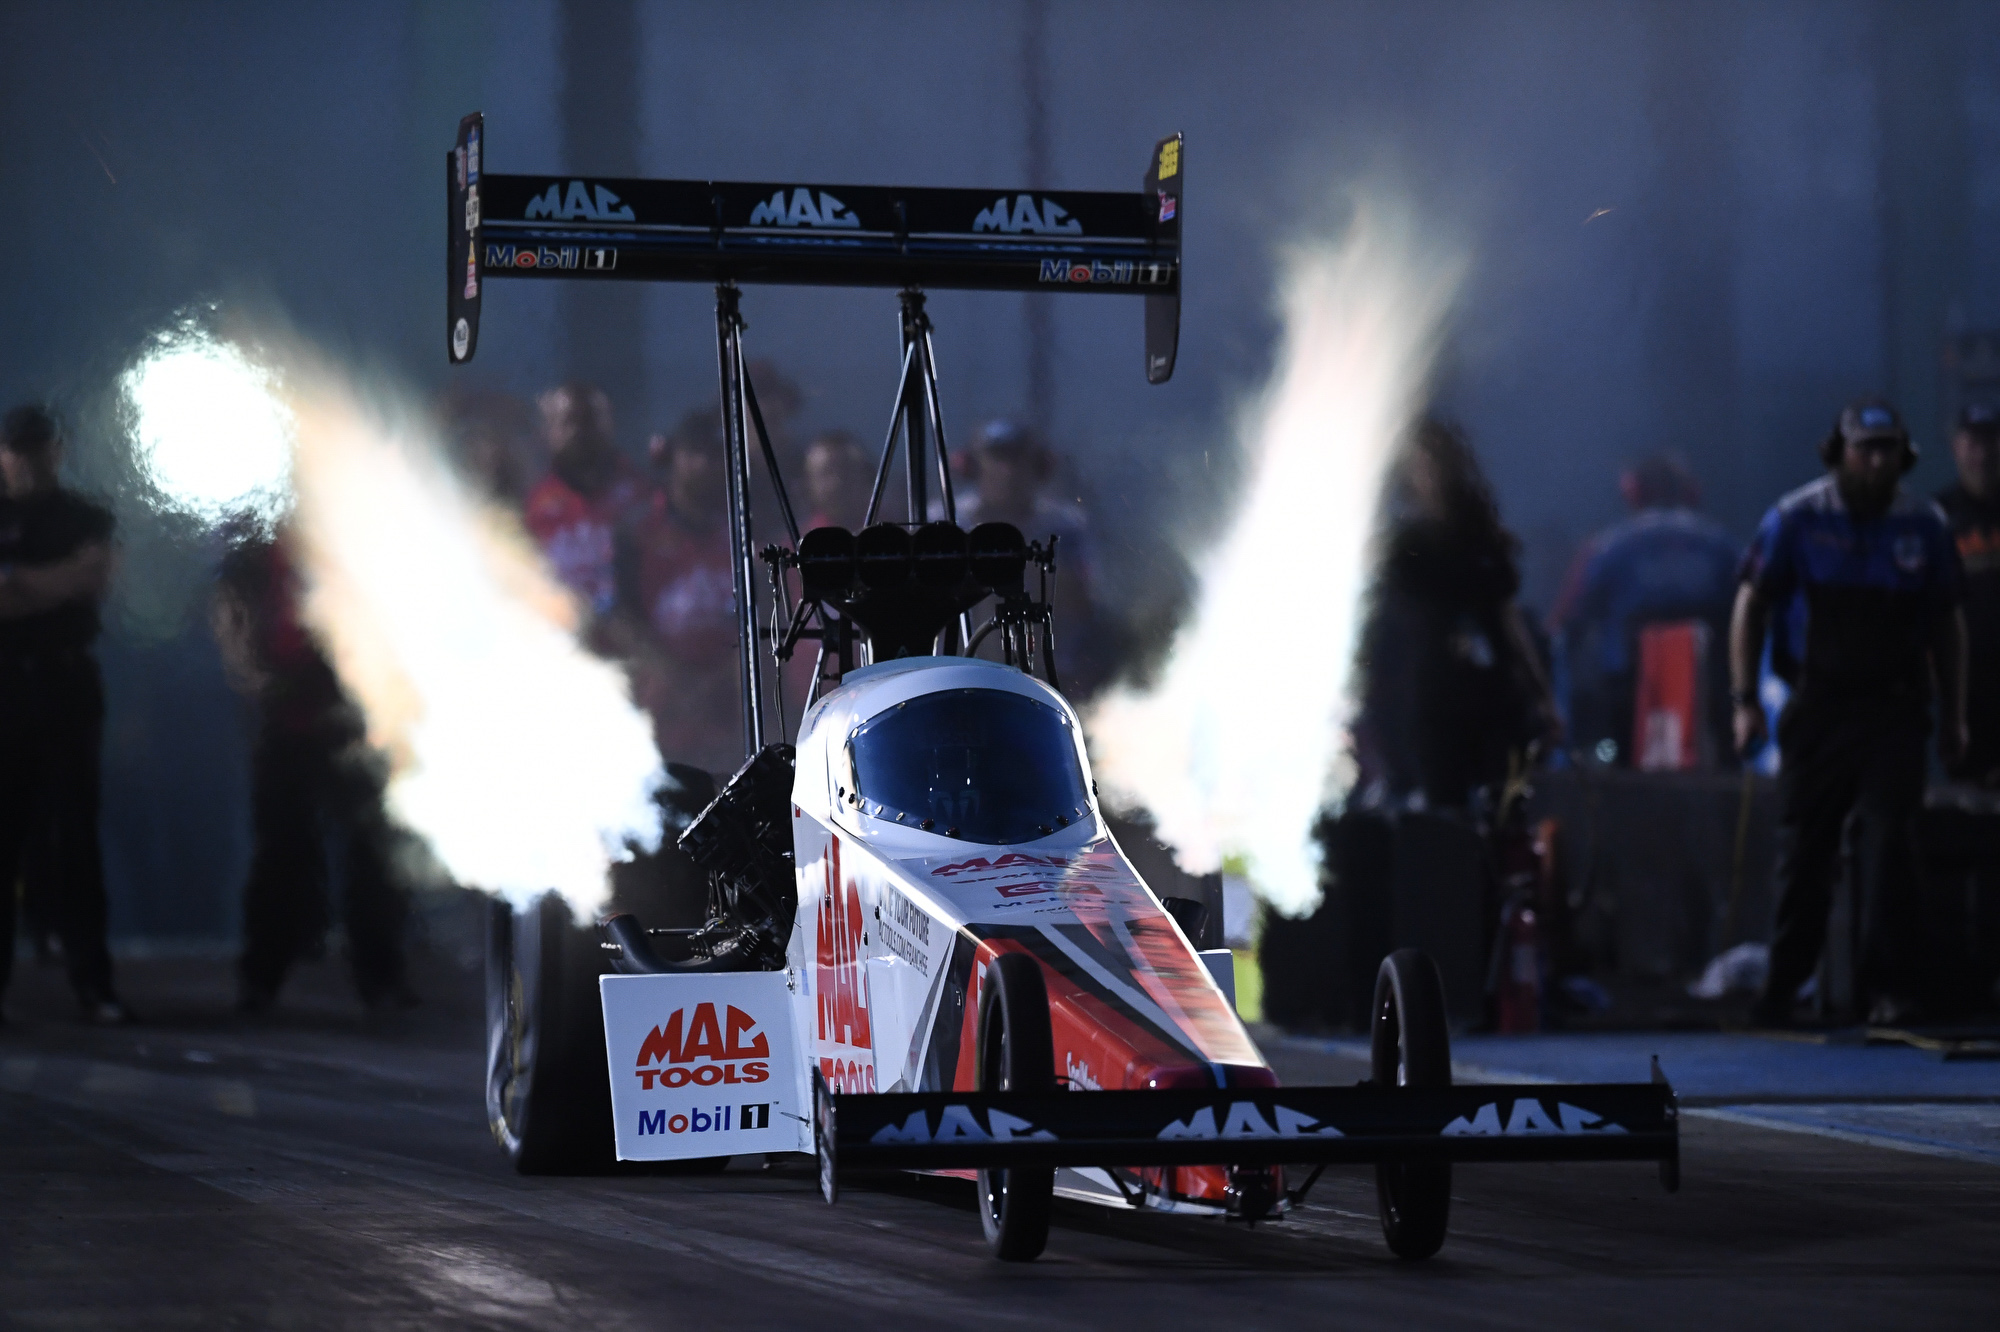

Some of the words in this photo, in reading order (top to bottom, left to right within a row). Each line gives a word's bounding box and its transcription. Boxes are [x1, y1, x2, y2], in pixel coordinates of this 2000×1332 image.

[524, 180, 636, 221] MAC
[750, 187, 861, 229] MAC
[972, 194, 1083, 236] MAC
[485, 245, 579, 270] Mobil
[1039, 258, 1133, 284] Mobil
[636, 1002, 770, 1067] MAC
[635, 1062, 770, 1090] TOOLS
[638, 1105, 731, 1136] Mobil
[869, 1104, 1060, 1142] MAC
[1156, 1101, 1346, 1140] MAC
[1440, 1098, 1630, 1136] MAC
